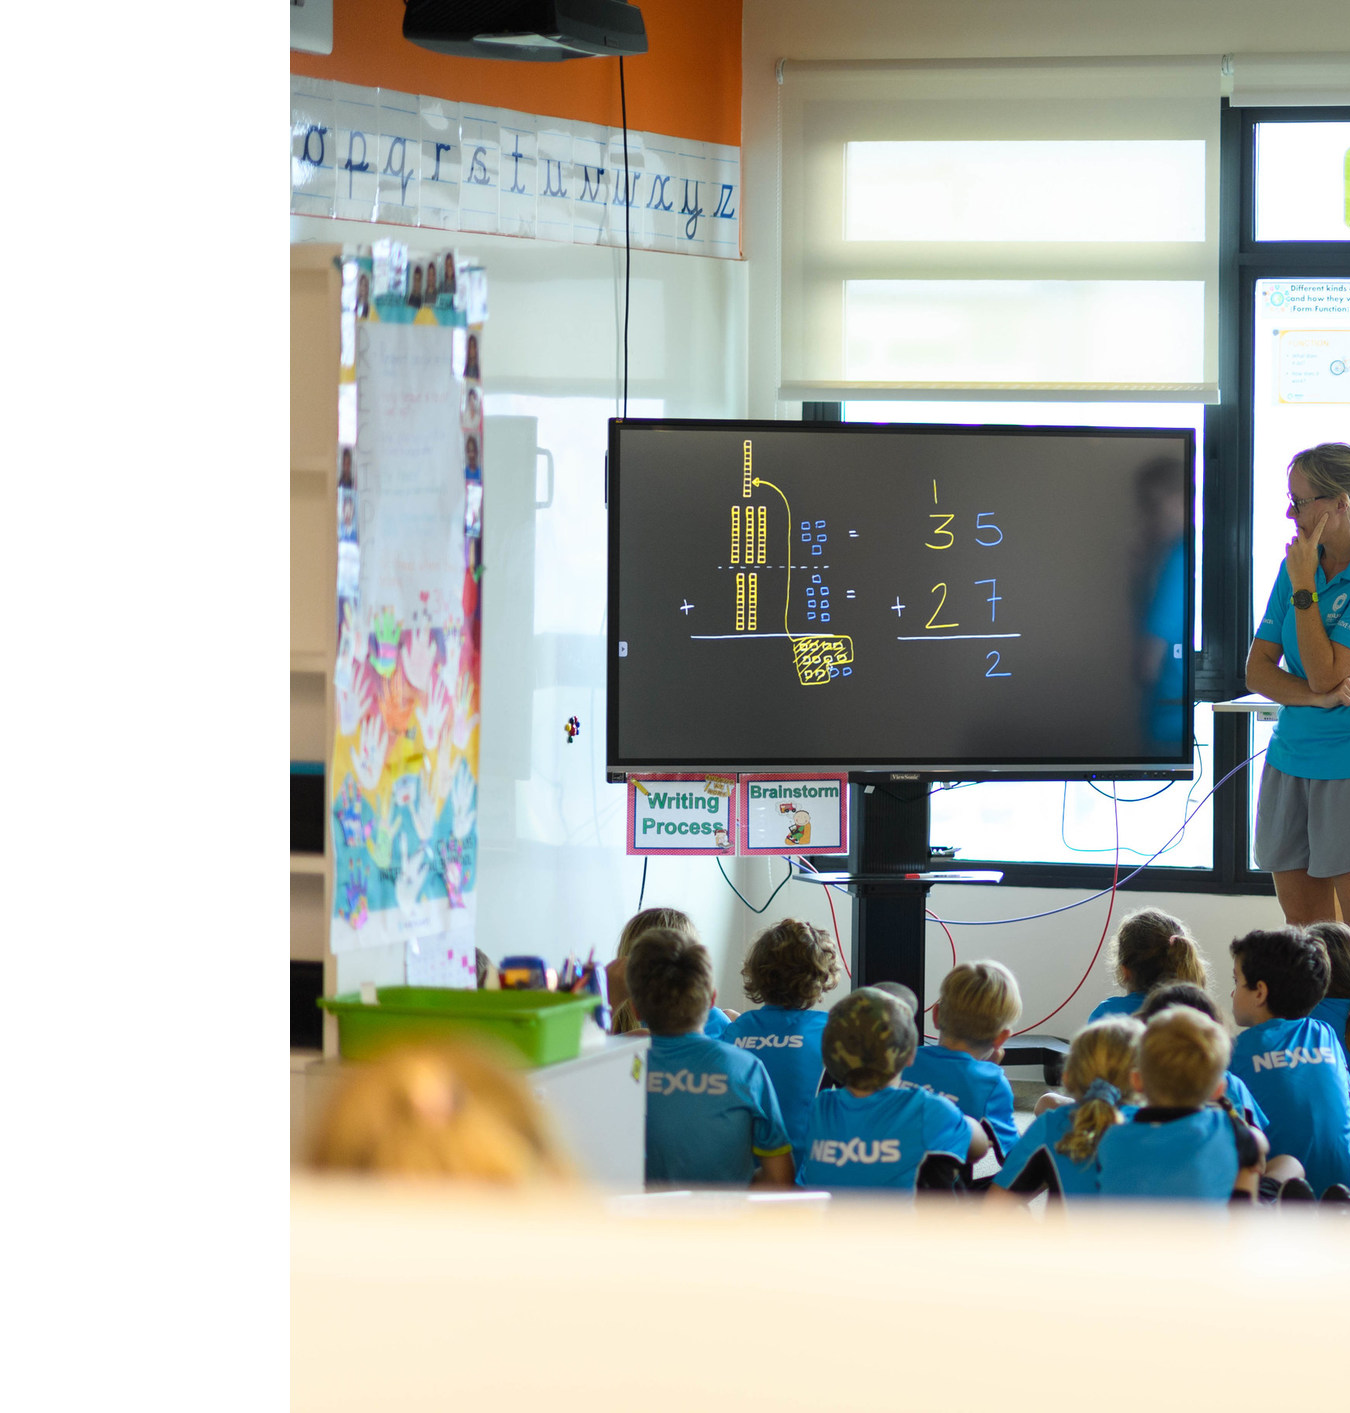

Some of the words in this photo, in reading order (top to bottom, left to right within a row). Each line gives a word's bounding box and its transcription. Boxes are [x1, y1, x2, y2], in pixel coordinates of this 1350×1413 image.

[345, 131, 369, 199] p
[383, 136, 414, 205] q
[431, 143, 451, 182] r
[467, 146, 490, 185] s
[510, 134, 526, 194] t
[543, 159, 567, 197] u
[612, 171, 641, 207] w
[646, 174, 673, 211] x
[681, 179, 703, 240] y
[713, 184, 735, 218] z
[1290, 284, 1325, 292] Different
[1326, 284, 1347, 292] kinds
[1290, 295, 1306, 303] and
[1307, 295, 1324, 303] how
[1327, 295, 1344, 305] they
[985, 650, 1012, 677] 2
[648, 791, 720, 813] Writing
[750, 785, 839, 799] Brainstorm
[642, 818, 724, 835] Process
[735, 1033, 804, 1050] NEXUS
[1252, 1046, 1337, 1074] NEXUS
[646, 1068, 728, 1096] EXUS
[810, 1137, 901, 1166] NEXUS
